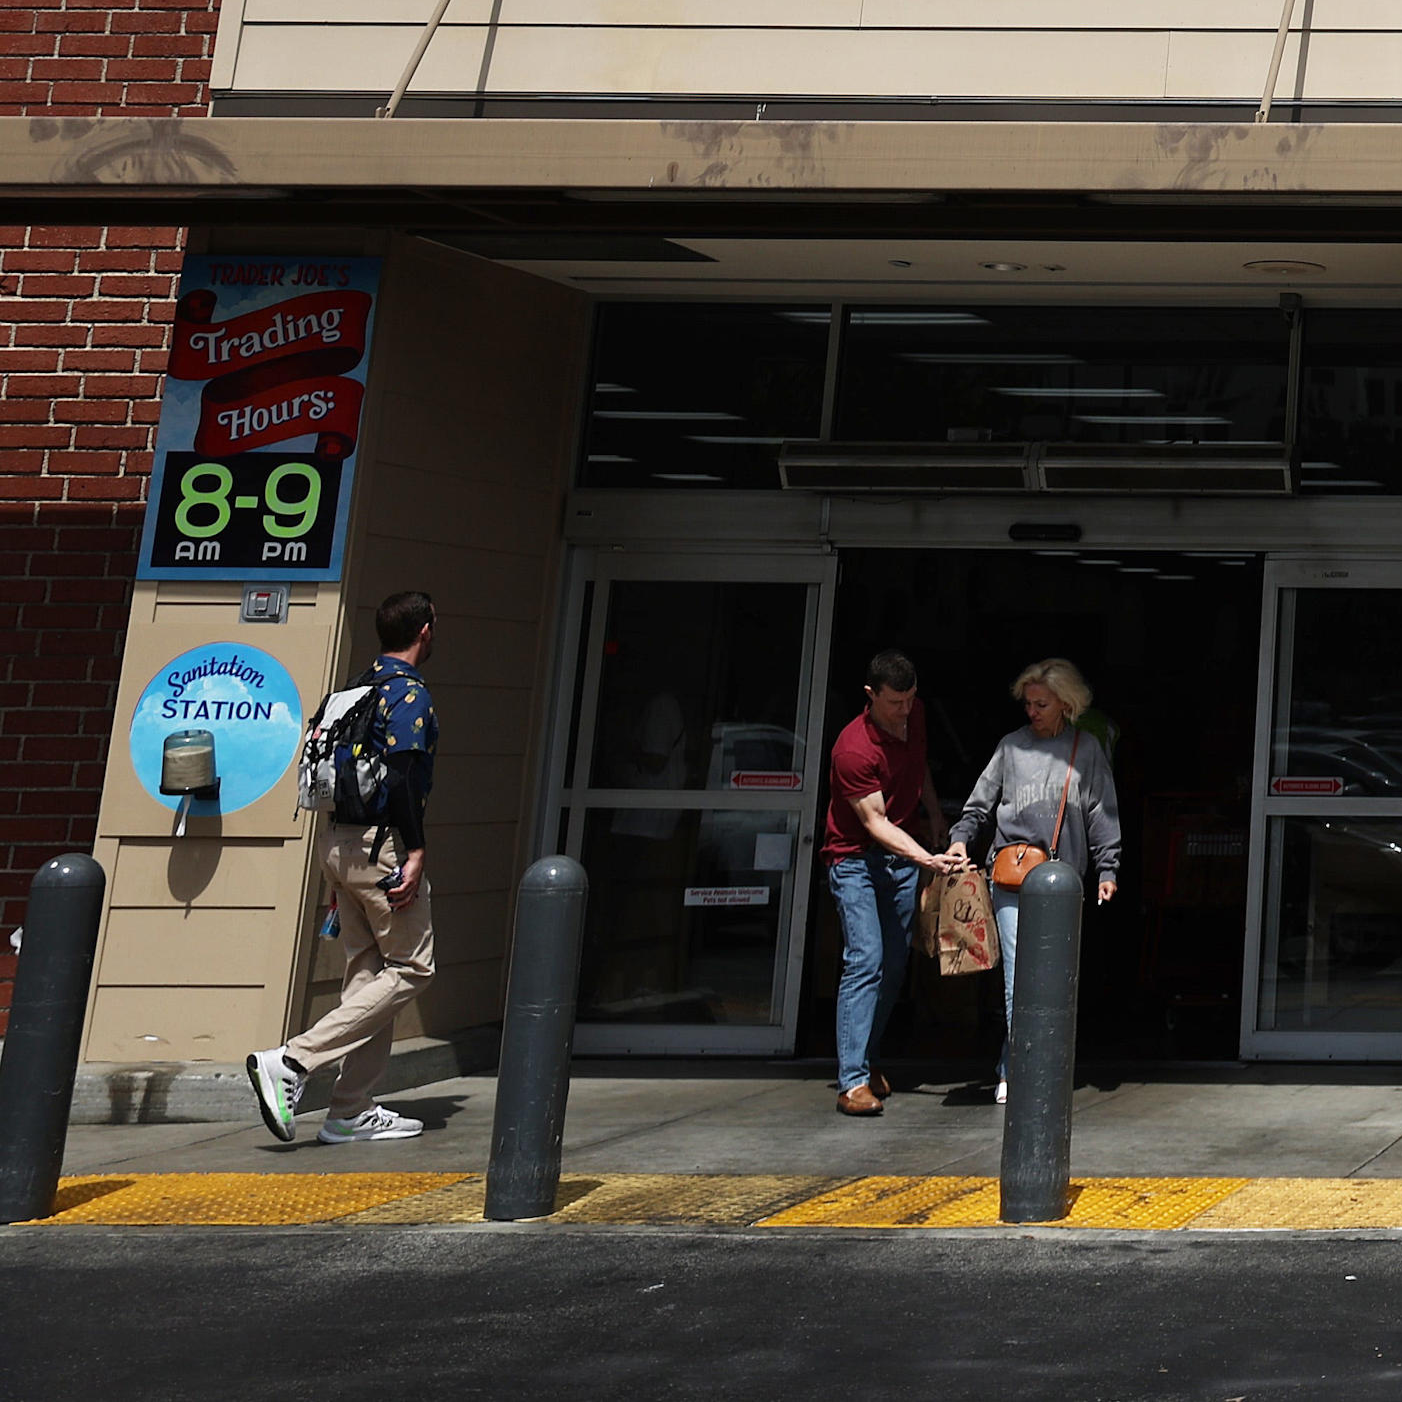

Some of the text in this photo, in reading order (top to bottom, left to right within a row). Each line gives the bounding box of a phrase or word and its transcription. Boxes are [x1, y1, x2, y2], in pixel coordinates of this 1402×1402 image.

[209, 263, 351, 287] TRADER JOE'S
[189, 307, 345, 364] Trading
[217, 390, 336, 441] Hours:
[174, 462, 322, 538] 8-9
[175, 541, 307, 561] AM PM
[168, 654, 266, 698] Sanitation
[161, 699, 273, 720] STATION
